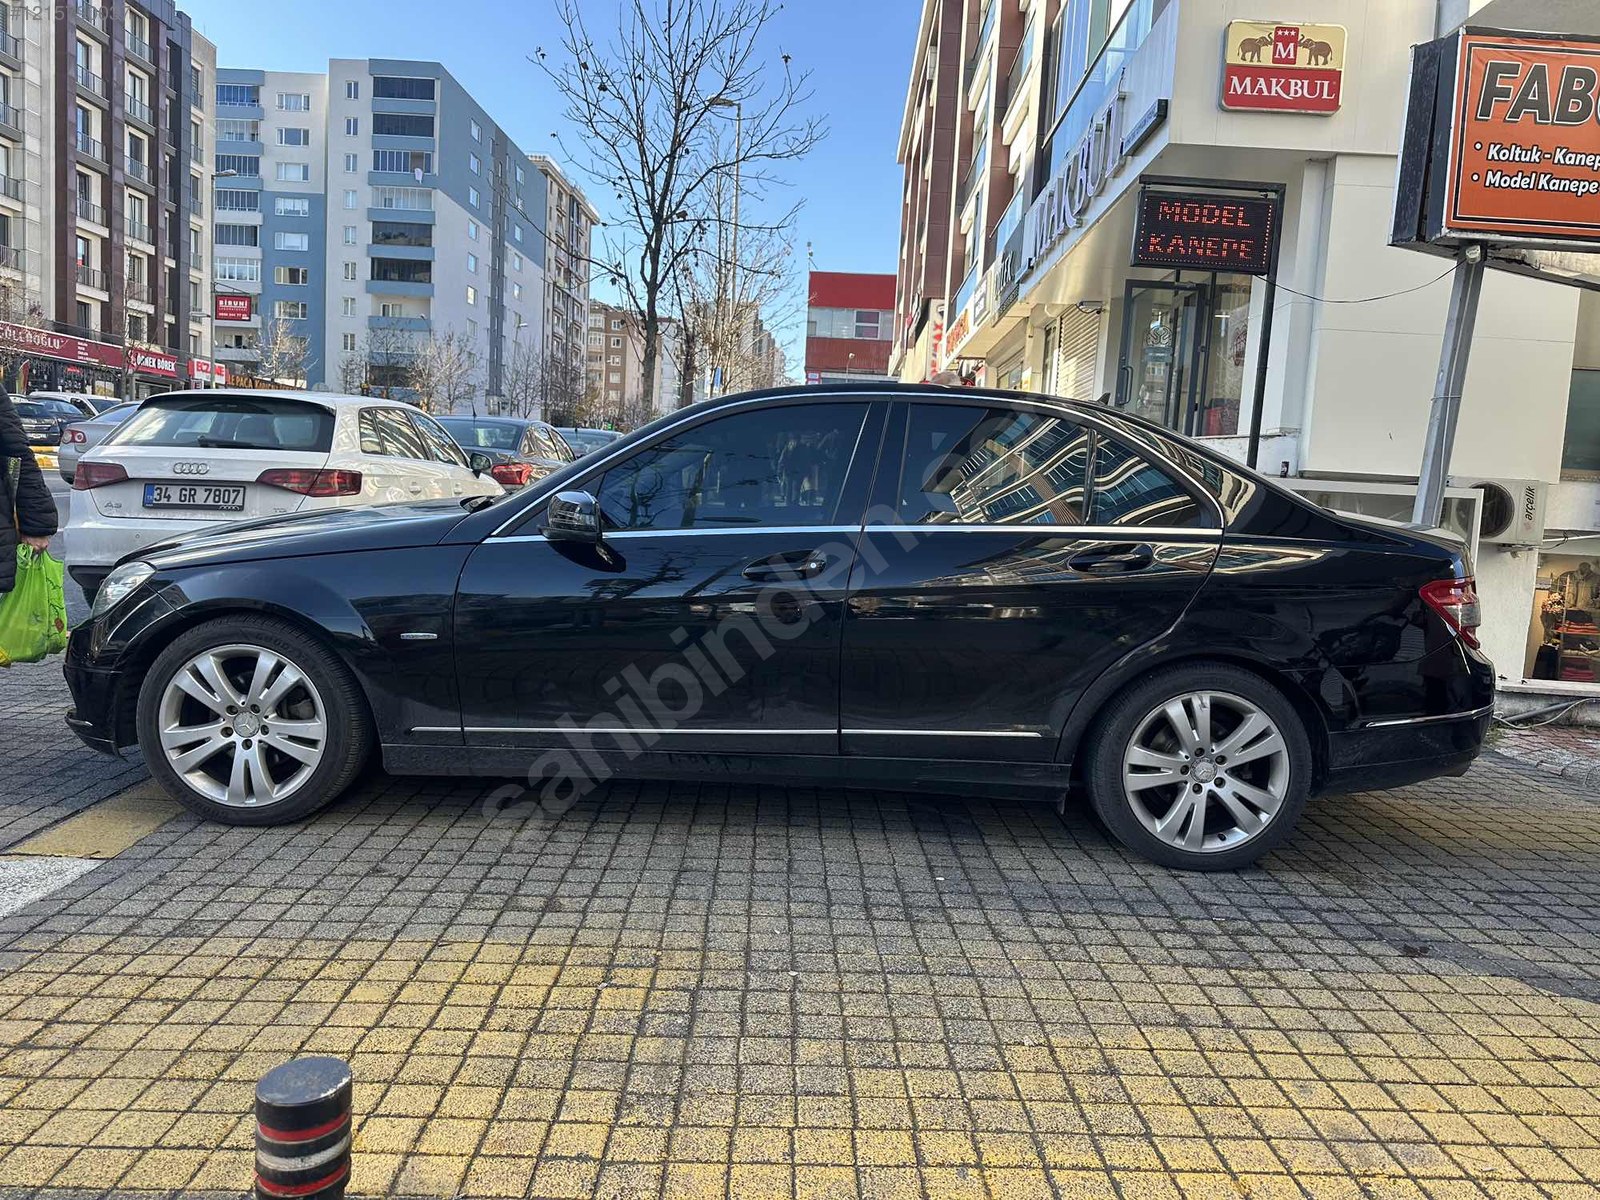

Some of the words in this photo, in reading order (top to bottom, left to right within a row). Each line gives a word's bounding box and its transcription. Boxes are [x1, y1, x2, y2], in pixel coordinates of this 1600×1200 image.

[1273, 42, 1295, 59] M
[1228, 76, 1336, 100] MAKBUL
[1474, 60, 1600, 127] FAB
[1486, 143, 1541, 163] Koltuk
[1031, 94, 1124, 266] MAKBUL
[1485, 170, 1535, 189] Model
[1537, 174, 1599, 196] Kanepe
[1159, 202, 1250, 227] MODEL
[1149, 233, 1254, 259] KANEPE
[154, 486, 172, 502] 34
[178, 487, 197, 503] GR
[203, 488, 241, 504] 7807
[1525, 486, 1535, 520] arçelik
